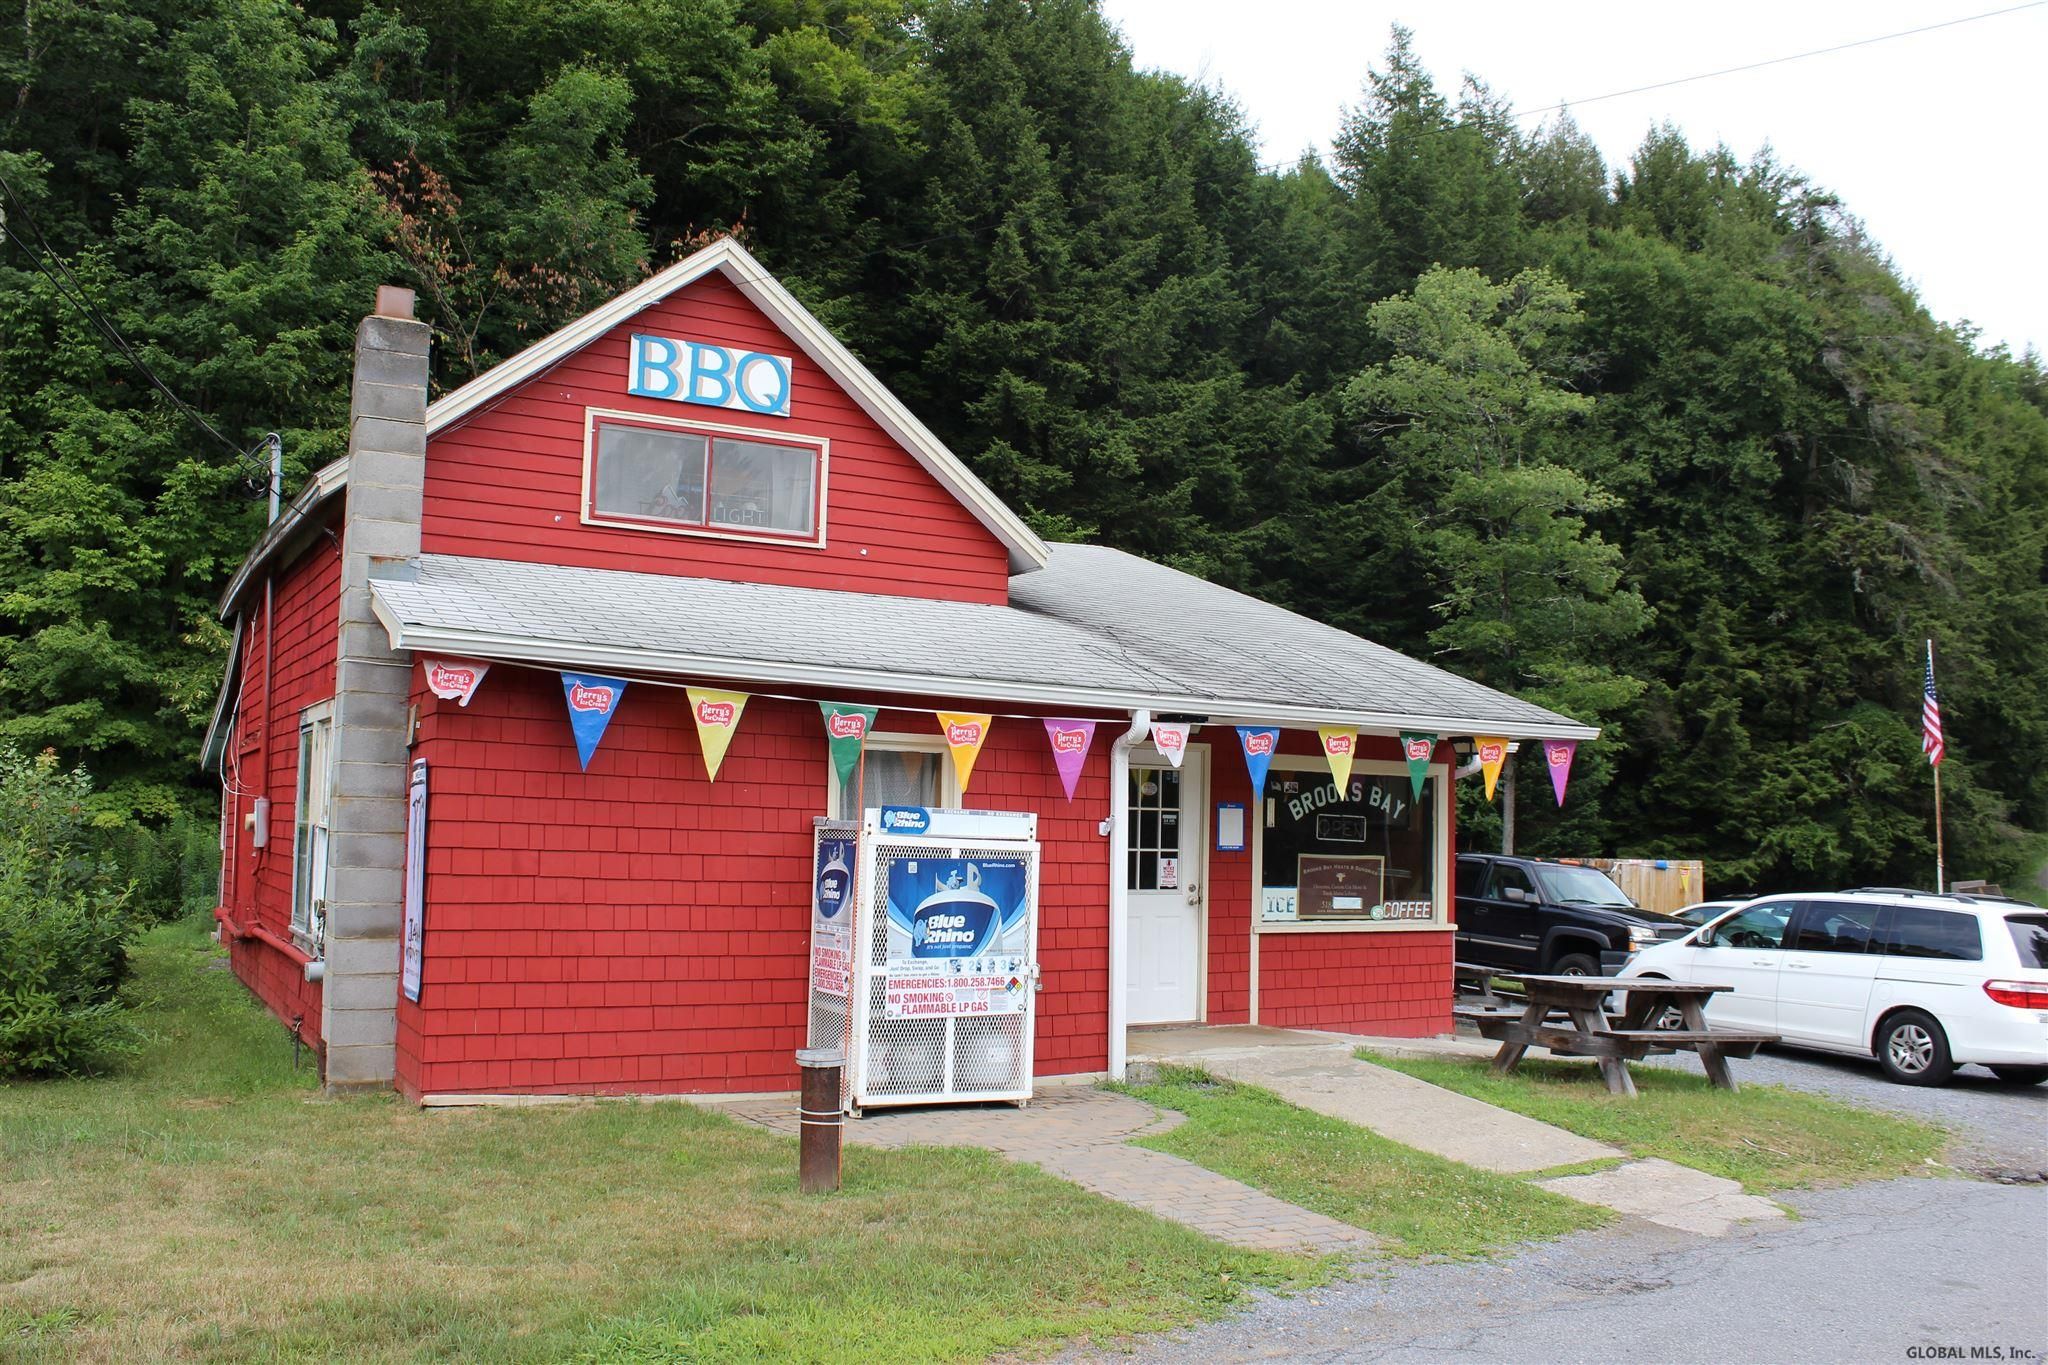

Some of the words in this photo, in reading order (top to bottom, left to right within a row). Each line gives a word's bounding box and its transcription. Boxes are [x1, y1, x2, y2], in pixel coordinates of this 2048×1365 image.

[630, 334, 789, 416] BBQ
[713, 507, 765, 524] LIGHT
[438, 669, 469, 684] Perry's
[576, 688, 608, 704] Perry's
[702, 704, 730, 718] Perry's
[834, 717, 860, 729] Perry's
[951, 726, 976, 738] Perry's
[1056, 732, 1082, 745] Perry's
[1158, 730, 1179, 742] Perry's
[1249, 736, 1268, 747] Perry's
[1329, 737, 1349, 747] Perry's
[1288, 782, 1362, 821] BROOS
[1369, 786, 1406, 819] BAY
[896, 810, 920, 819] Blue
[894, 818, 925, 829] Rhino
[1319, 819, 1363, 838] OPEN
[1266, 896, 1295, 913] ICE
[1383, 902, 1431, 918] COFFEE
[928, 914, 966, 929] Blue
[924, 929, 974, 944] Rhino
[822, 948, 841, 960] SMOKING
[888, 978, 947, 990] EMERGENCIES:
[888, 994, 900, 1004] NO
[904, 992, 944, 1004] SMOKING
[901, 1003, 956, 1014] FLAMMABLE
[959, 1003, 970, 1012] LP
[972, 1001, 988, 1012] GAS
